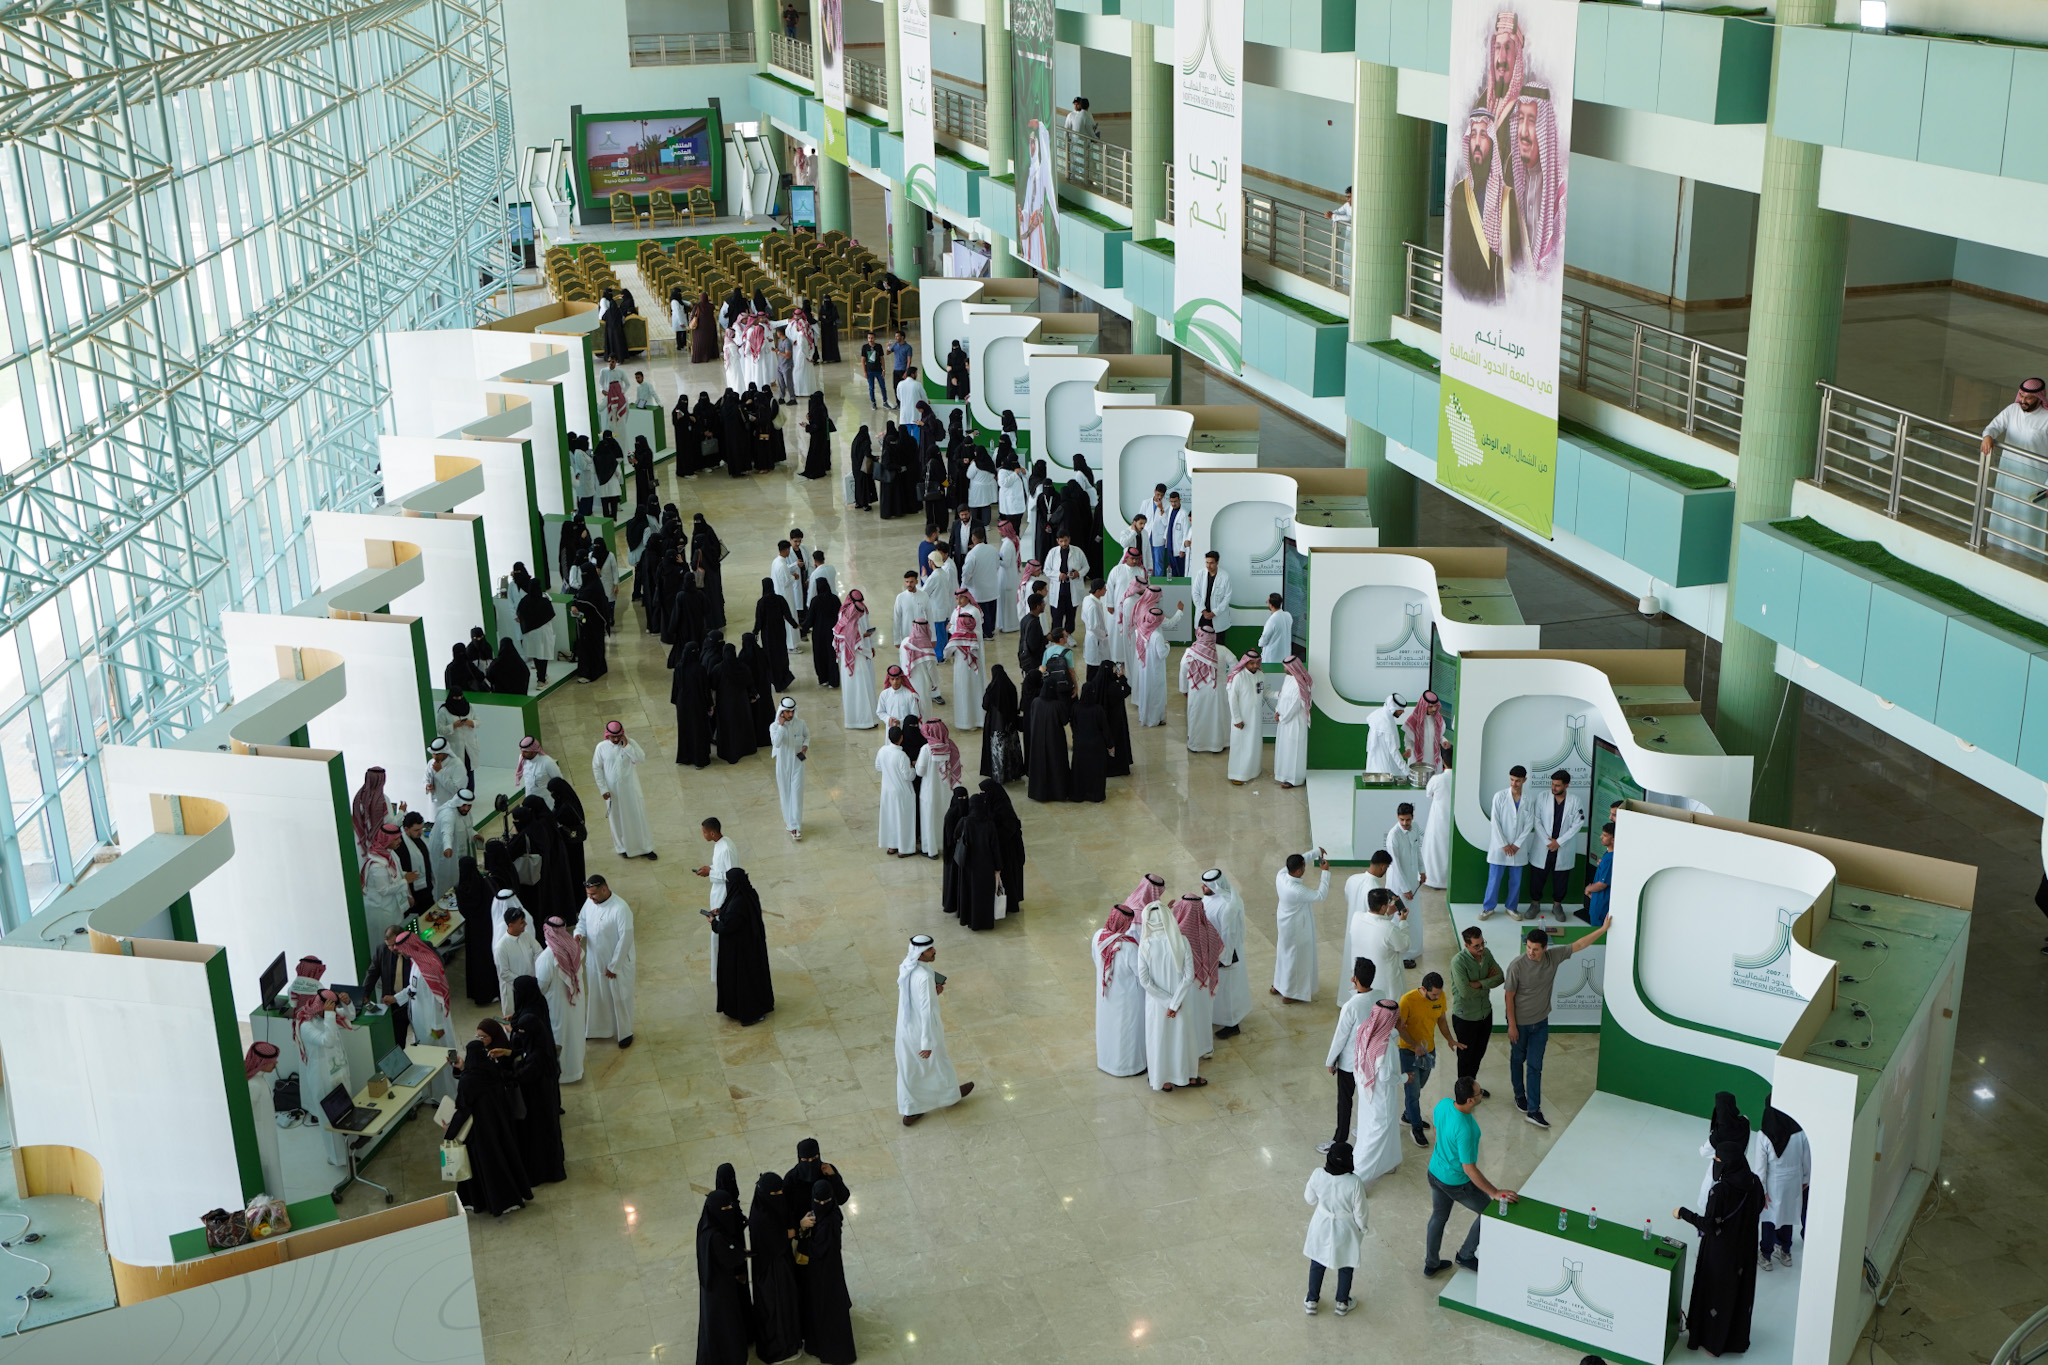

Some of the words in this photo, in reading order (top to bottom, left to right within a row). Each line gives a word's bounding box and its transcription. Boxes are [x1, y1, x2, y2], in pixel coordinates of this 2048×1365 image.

[1189, 201, 1226, 239] بكم
[1475, 331, 1497, 350] بكم
[1449, 342, 1481, 366] الشمالية
[1482, 358, 1508, 377] الحدود
[1509, 365, 1535, 391] جامعة
[1537, 380, 1553, 394] في
[1481, 433, 1499, 451] الوطن
[1538, 460, 1547, 473] من
[1733, 968, 1770, 982] الشمالية
[1766, 968, 1781, 976] 2007
[1733, 977, 1768, 991] NORTHERN
[1768, 984, 1796, 996] BORDER
[1526, 1294, 1558, 1308] الشمالية
[1526, 1300, 1557, 1313] NORTHERN
[1557, 1309, 1580, 1320] BORDER
[1580, 1316, 1614, 1330] UNIVERSITY
[1560, 1305, 1586, 1316] الحدود
[1587, 1313, 1614, 1325] جامعة
